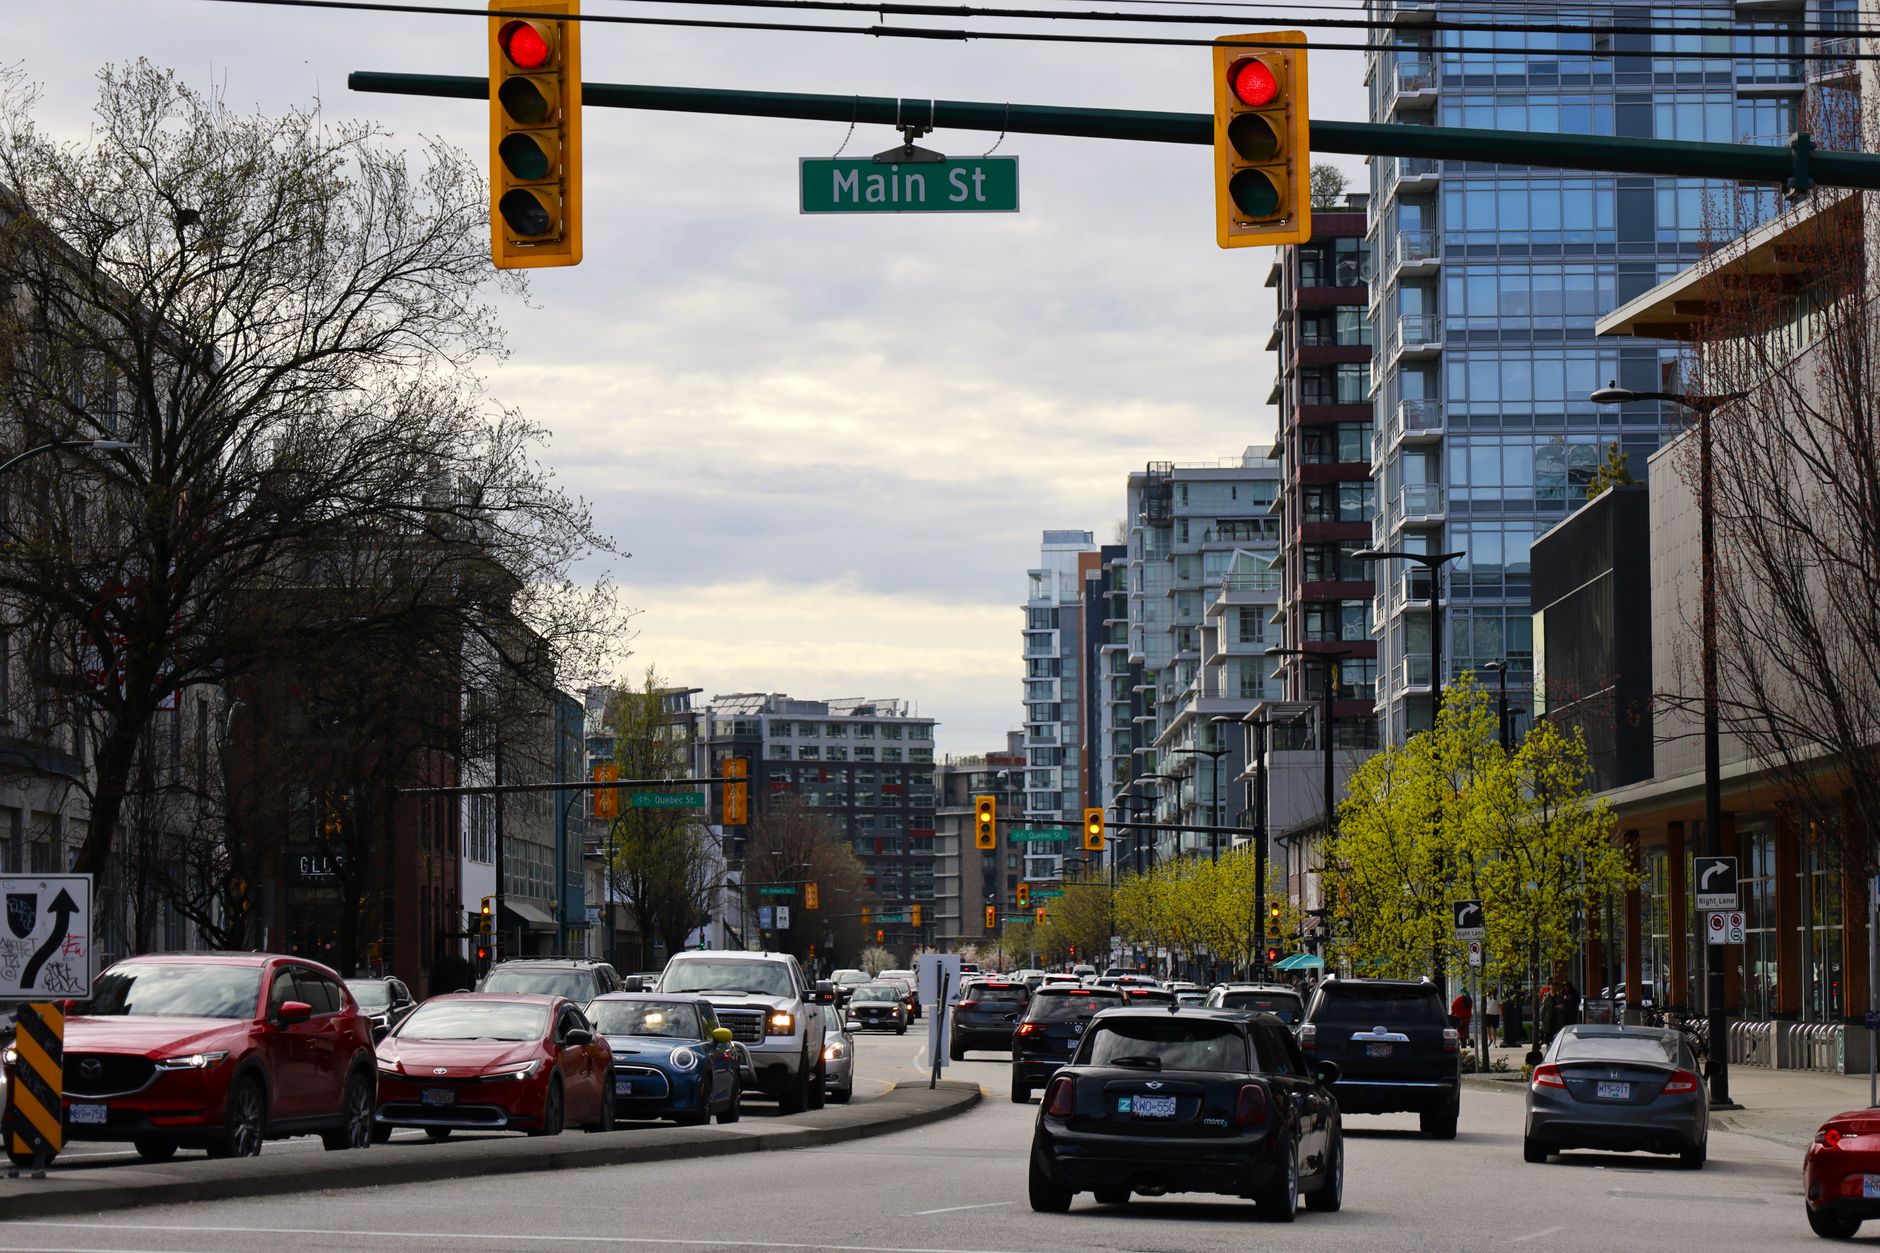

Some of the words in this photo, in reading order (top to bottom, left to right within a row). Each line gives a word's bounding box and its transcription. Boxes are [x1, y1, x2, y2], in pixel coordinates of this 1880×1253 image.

[832, 164, 926, 202] Main
[948, 167, 986, 202] St
[655, 795, 682, 804] Quebec
[1698, 897, 1716, 906] Right
[1718, 897, 1735, 905] Lane
